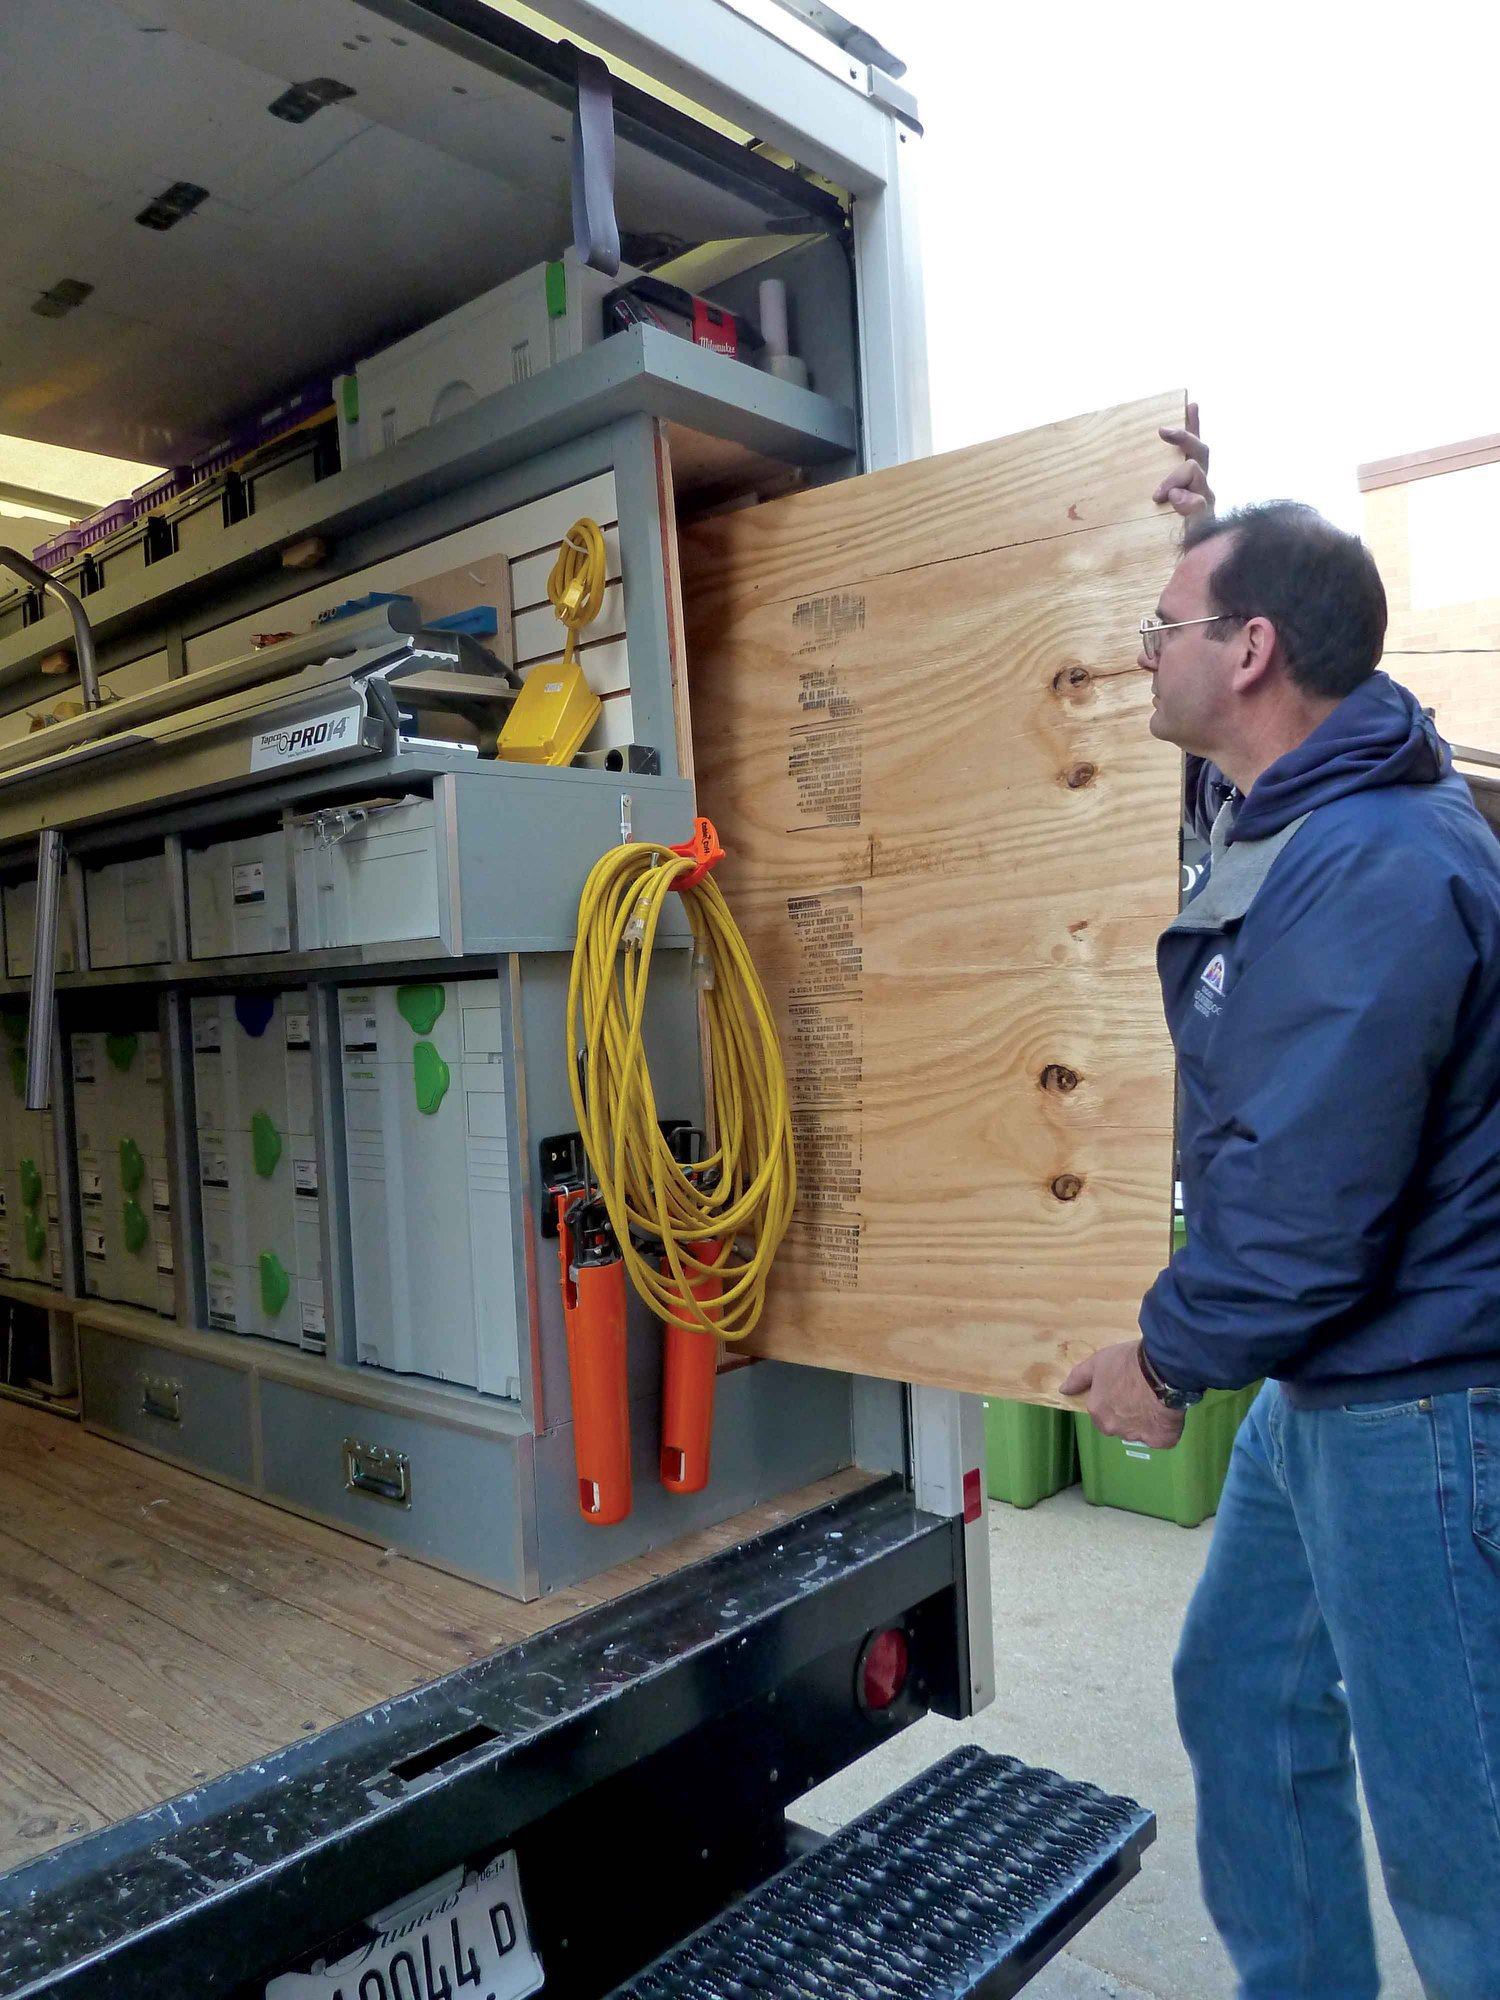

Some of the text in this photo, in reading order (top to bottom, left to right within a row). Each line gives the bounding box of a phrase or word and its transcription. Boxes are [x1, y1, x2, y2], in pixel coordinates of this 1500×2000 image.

[699, 337, 735, 353] Milwaukee
[261, 733, 282, 745] Tapco
[488, 1902, 517, 1958] D
